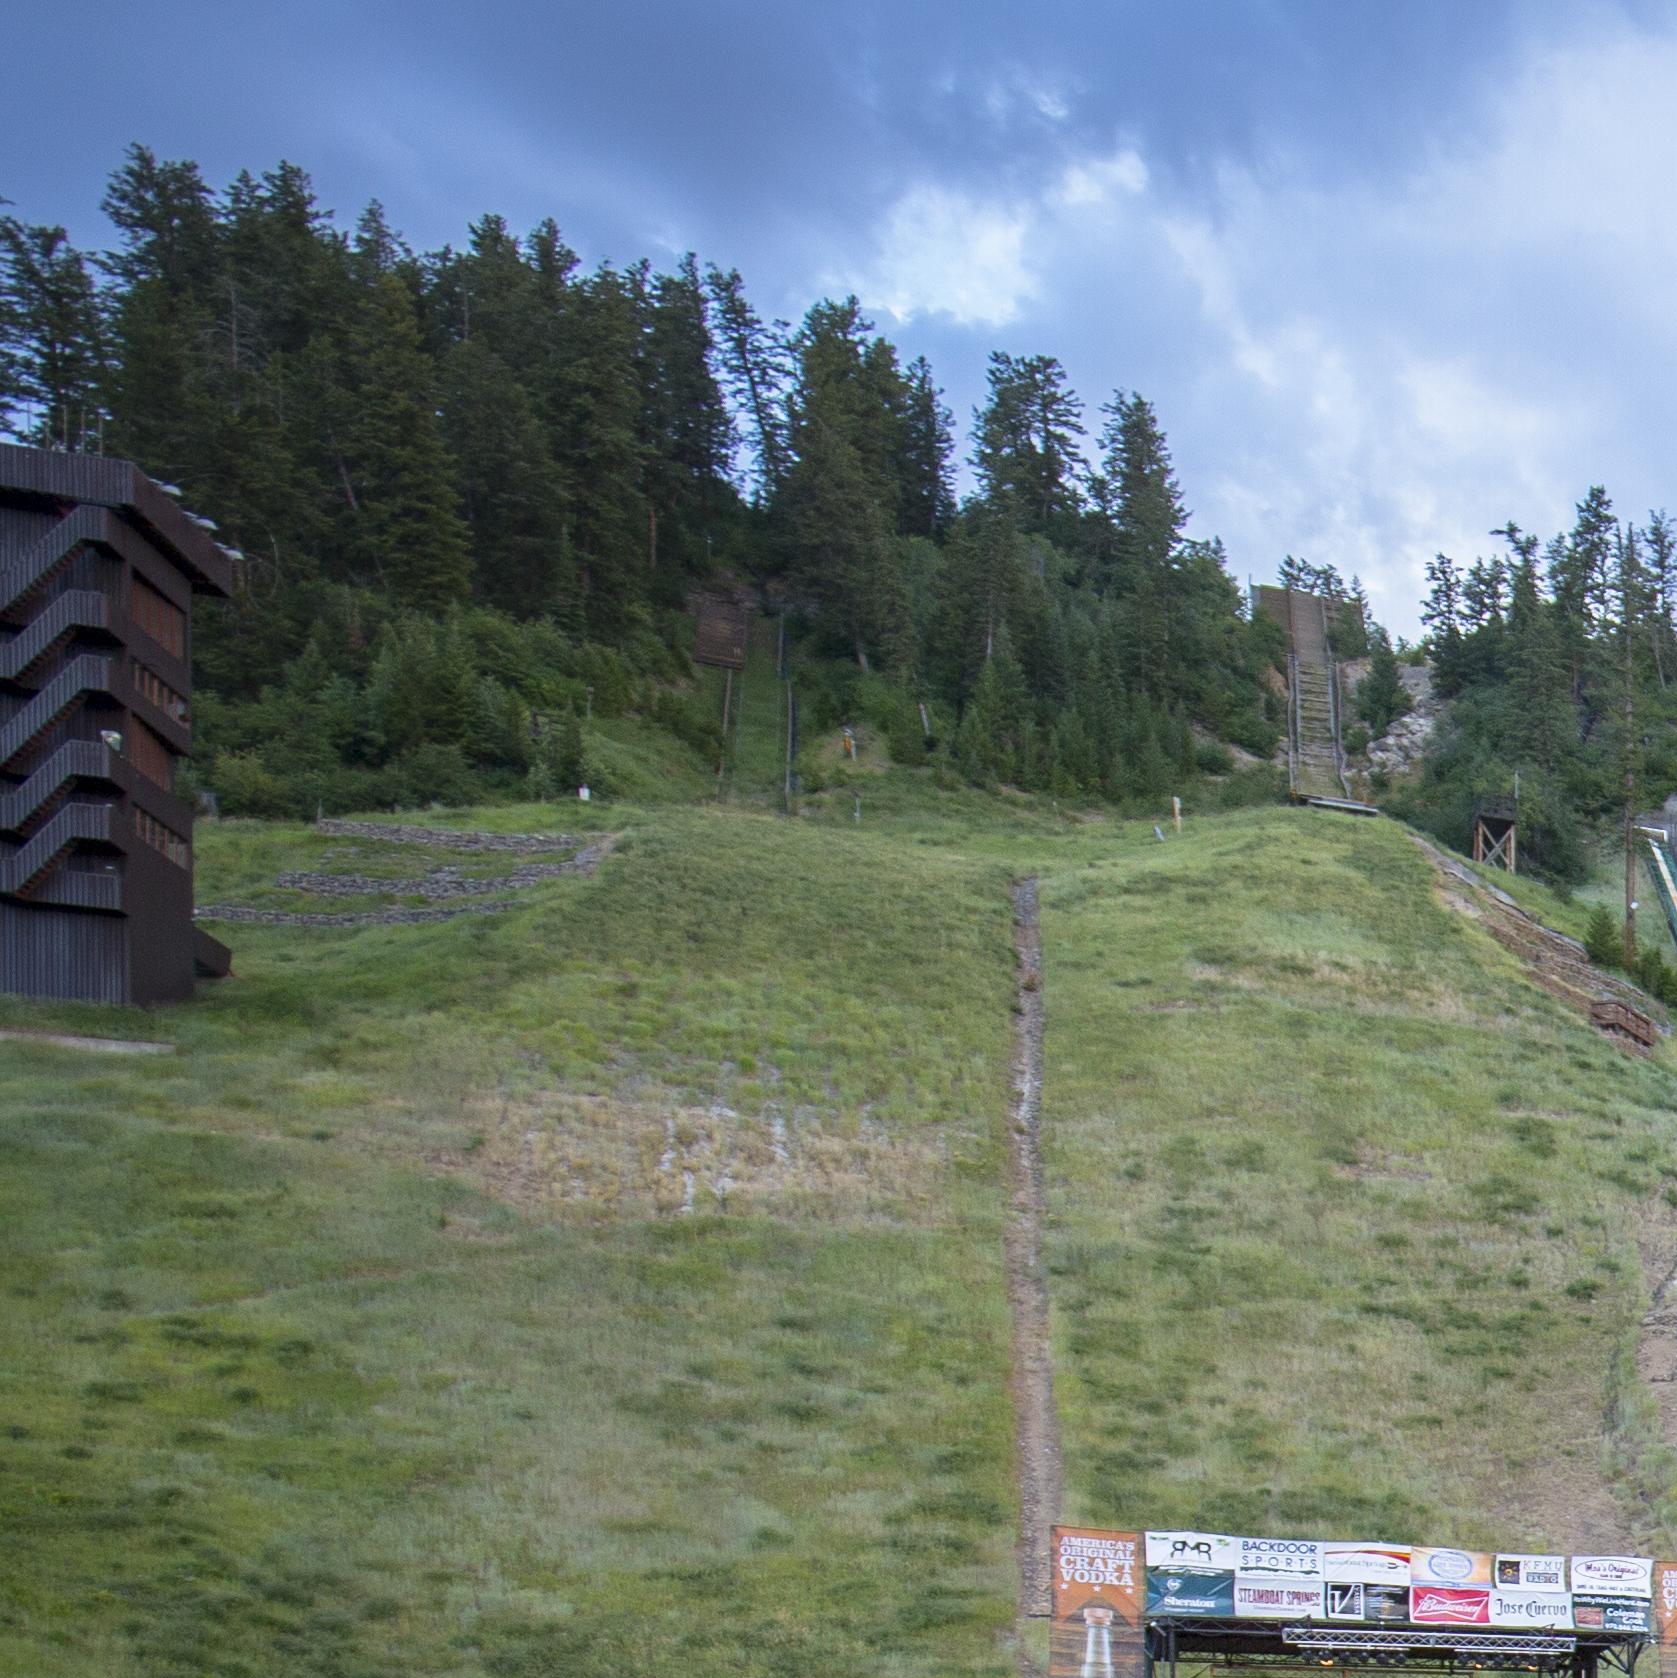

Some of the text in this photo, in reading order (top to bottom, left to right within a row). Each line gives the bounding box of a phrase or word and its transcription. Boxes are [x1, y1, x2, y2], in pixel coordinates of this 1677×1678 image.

[1060, 1536, 1135, 1550] AMERICA'S
[1241, 1540, 1317, 1554] BACKDOOR
[1060, 1545, 1135, 1559] ORIGINAL
[1060, 1555, 1135, 1573] CRAFT
[1060, 1568, 1135, 1585] VODKA
[1163, 1596, 1216, 1608] Sheraton
[1238, 1588, 1284, 1604] STEAMBOAT
[1419, 1598, 1480, 1613] Budweiser
[1495, 1598, 1567, 1617] Jose Cuervo
